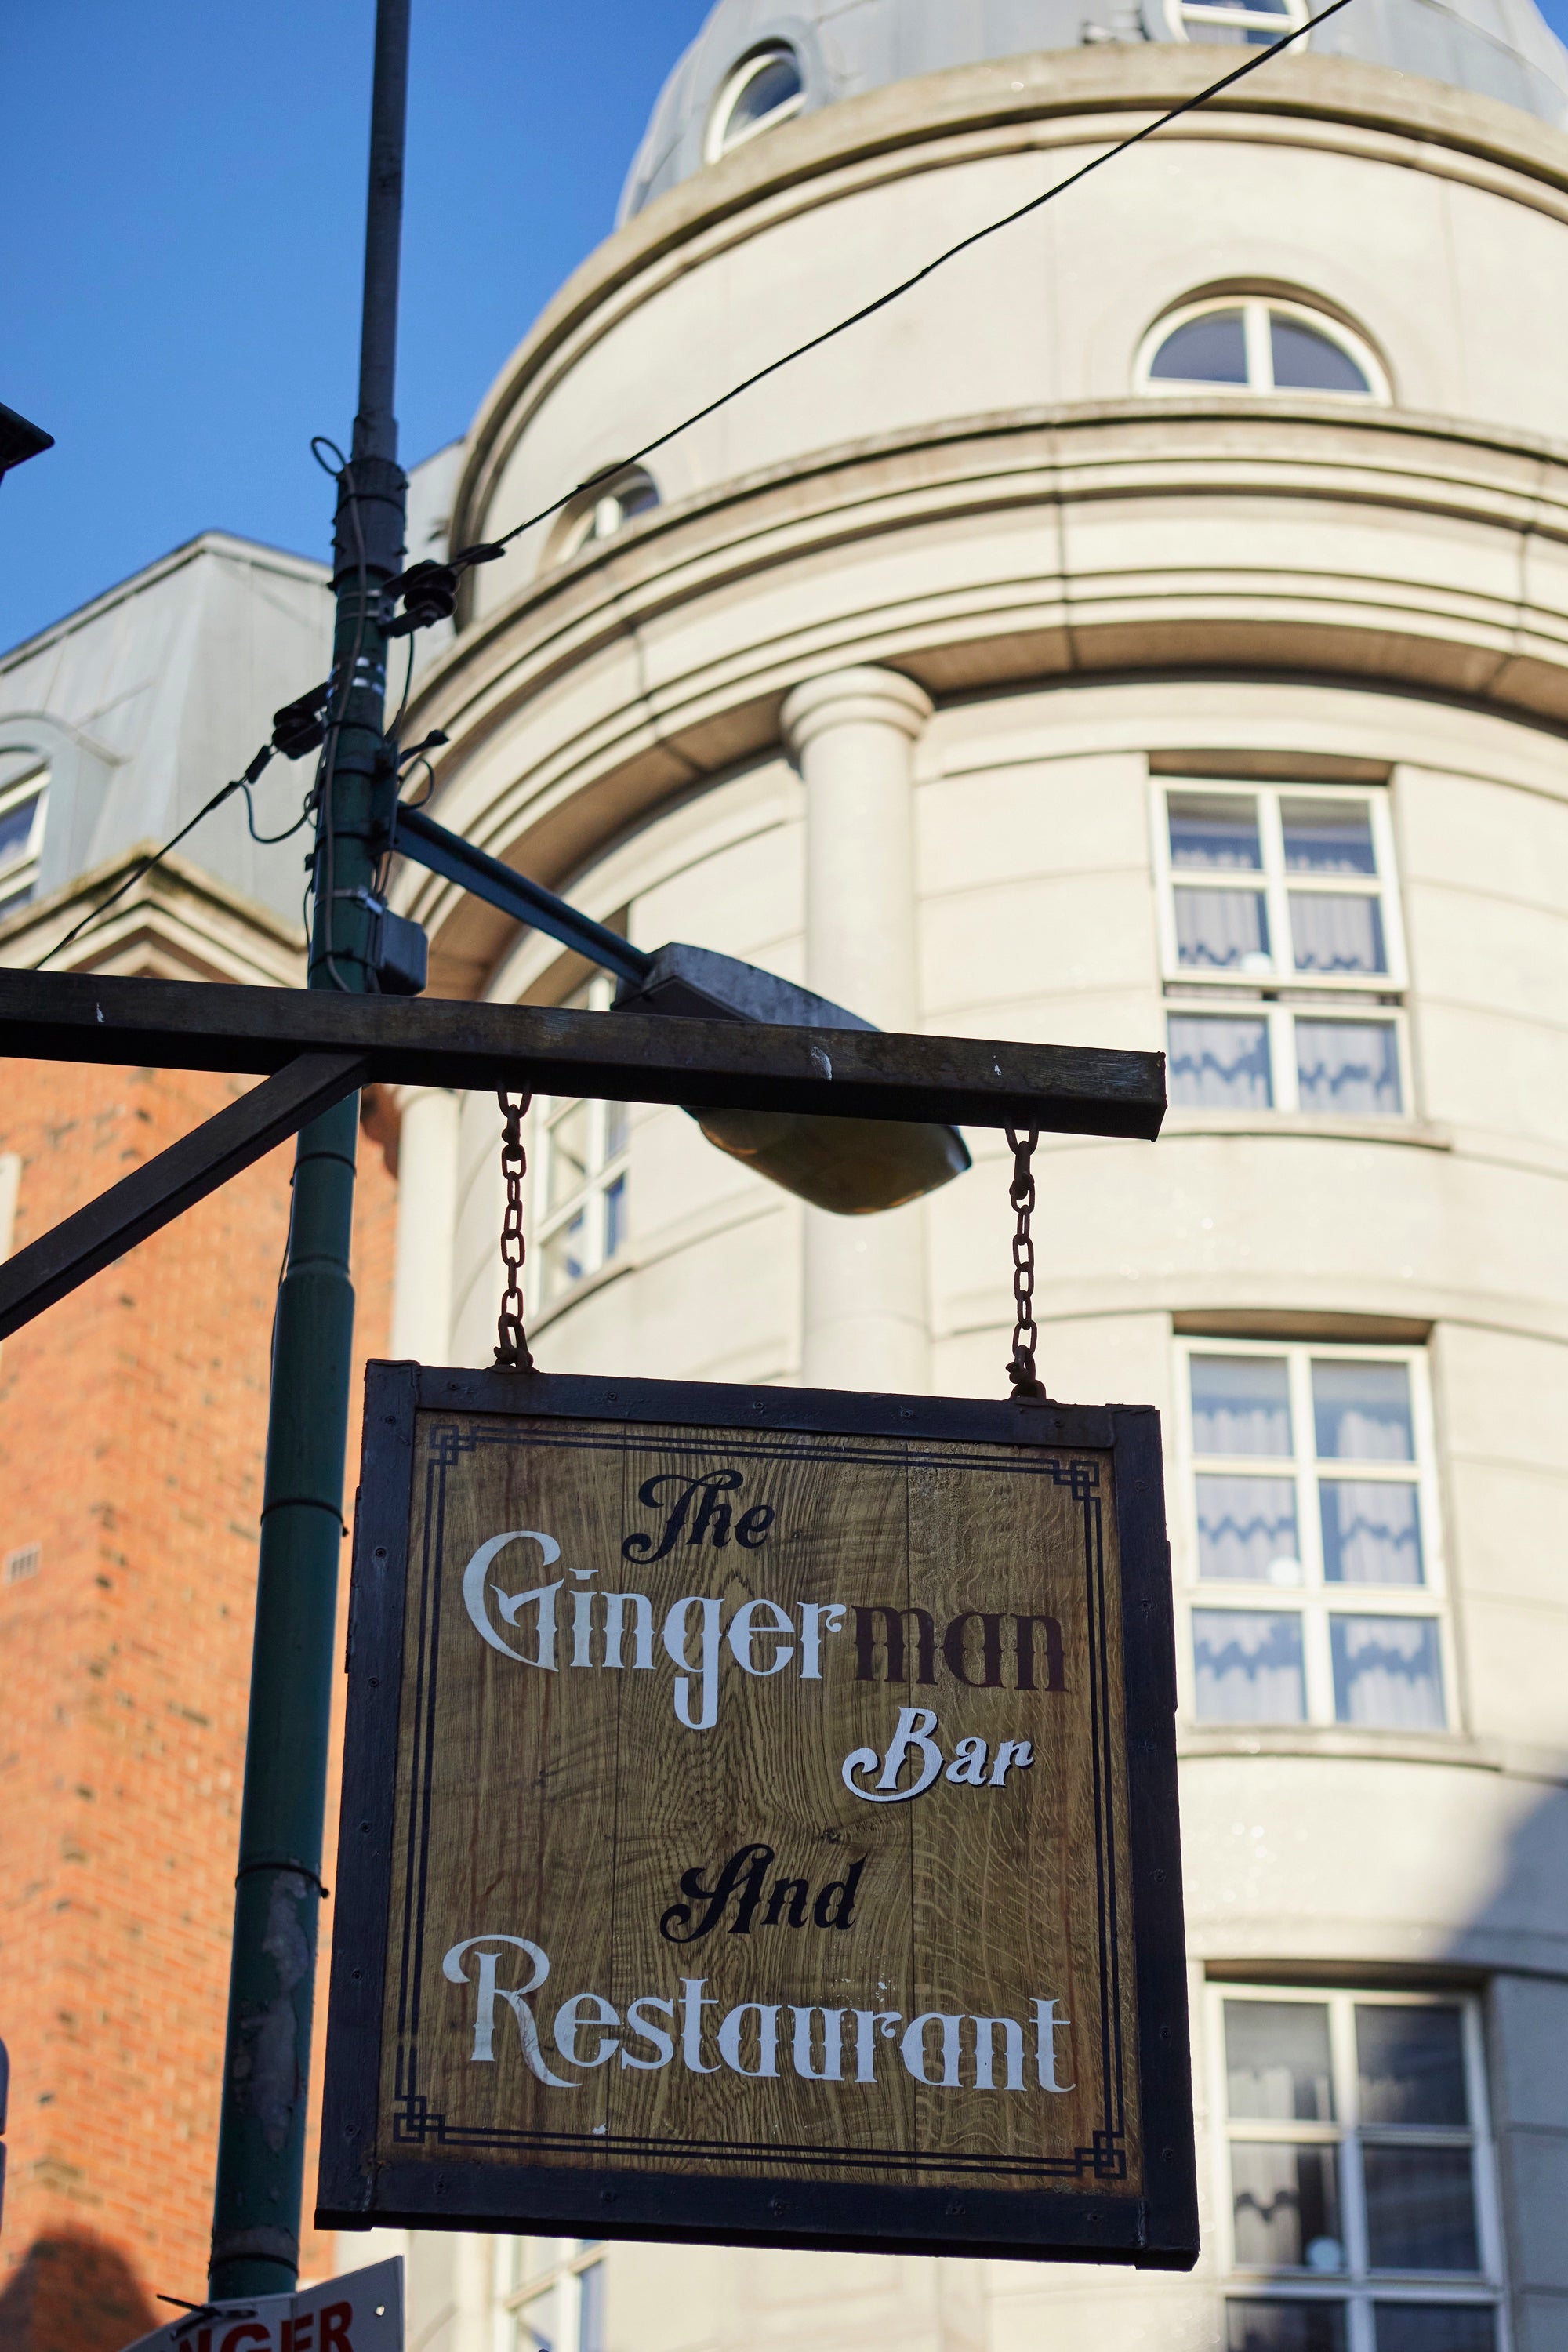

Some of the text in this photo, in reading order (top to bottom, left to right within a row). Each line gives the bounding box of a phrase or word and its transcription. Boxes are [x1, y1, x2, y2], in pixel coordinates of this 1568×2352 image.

[622, 1468, 775, 1565] The
[841, 1706, 1034, 1803] Bar
[659, 1843, 867, 1944] And
[441, 1933, 1076, 2094] Restaurant
